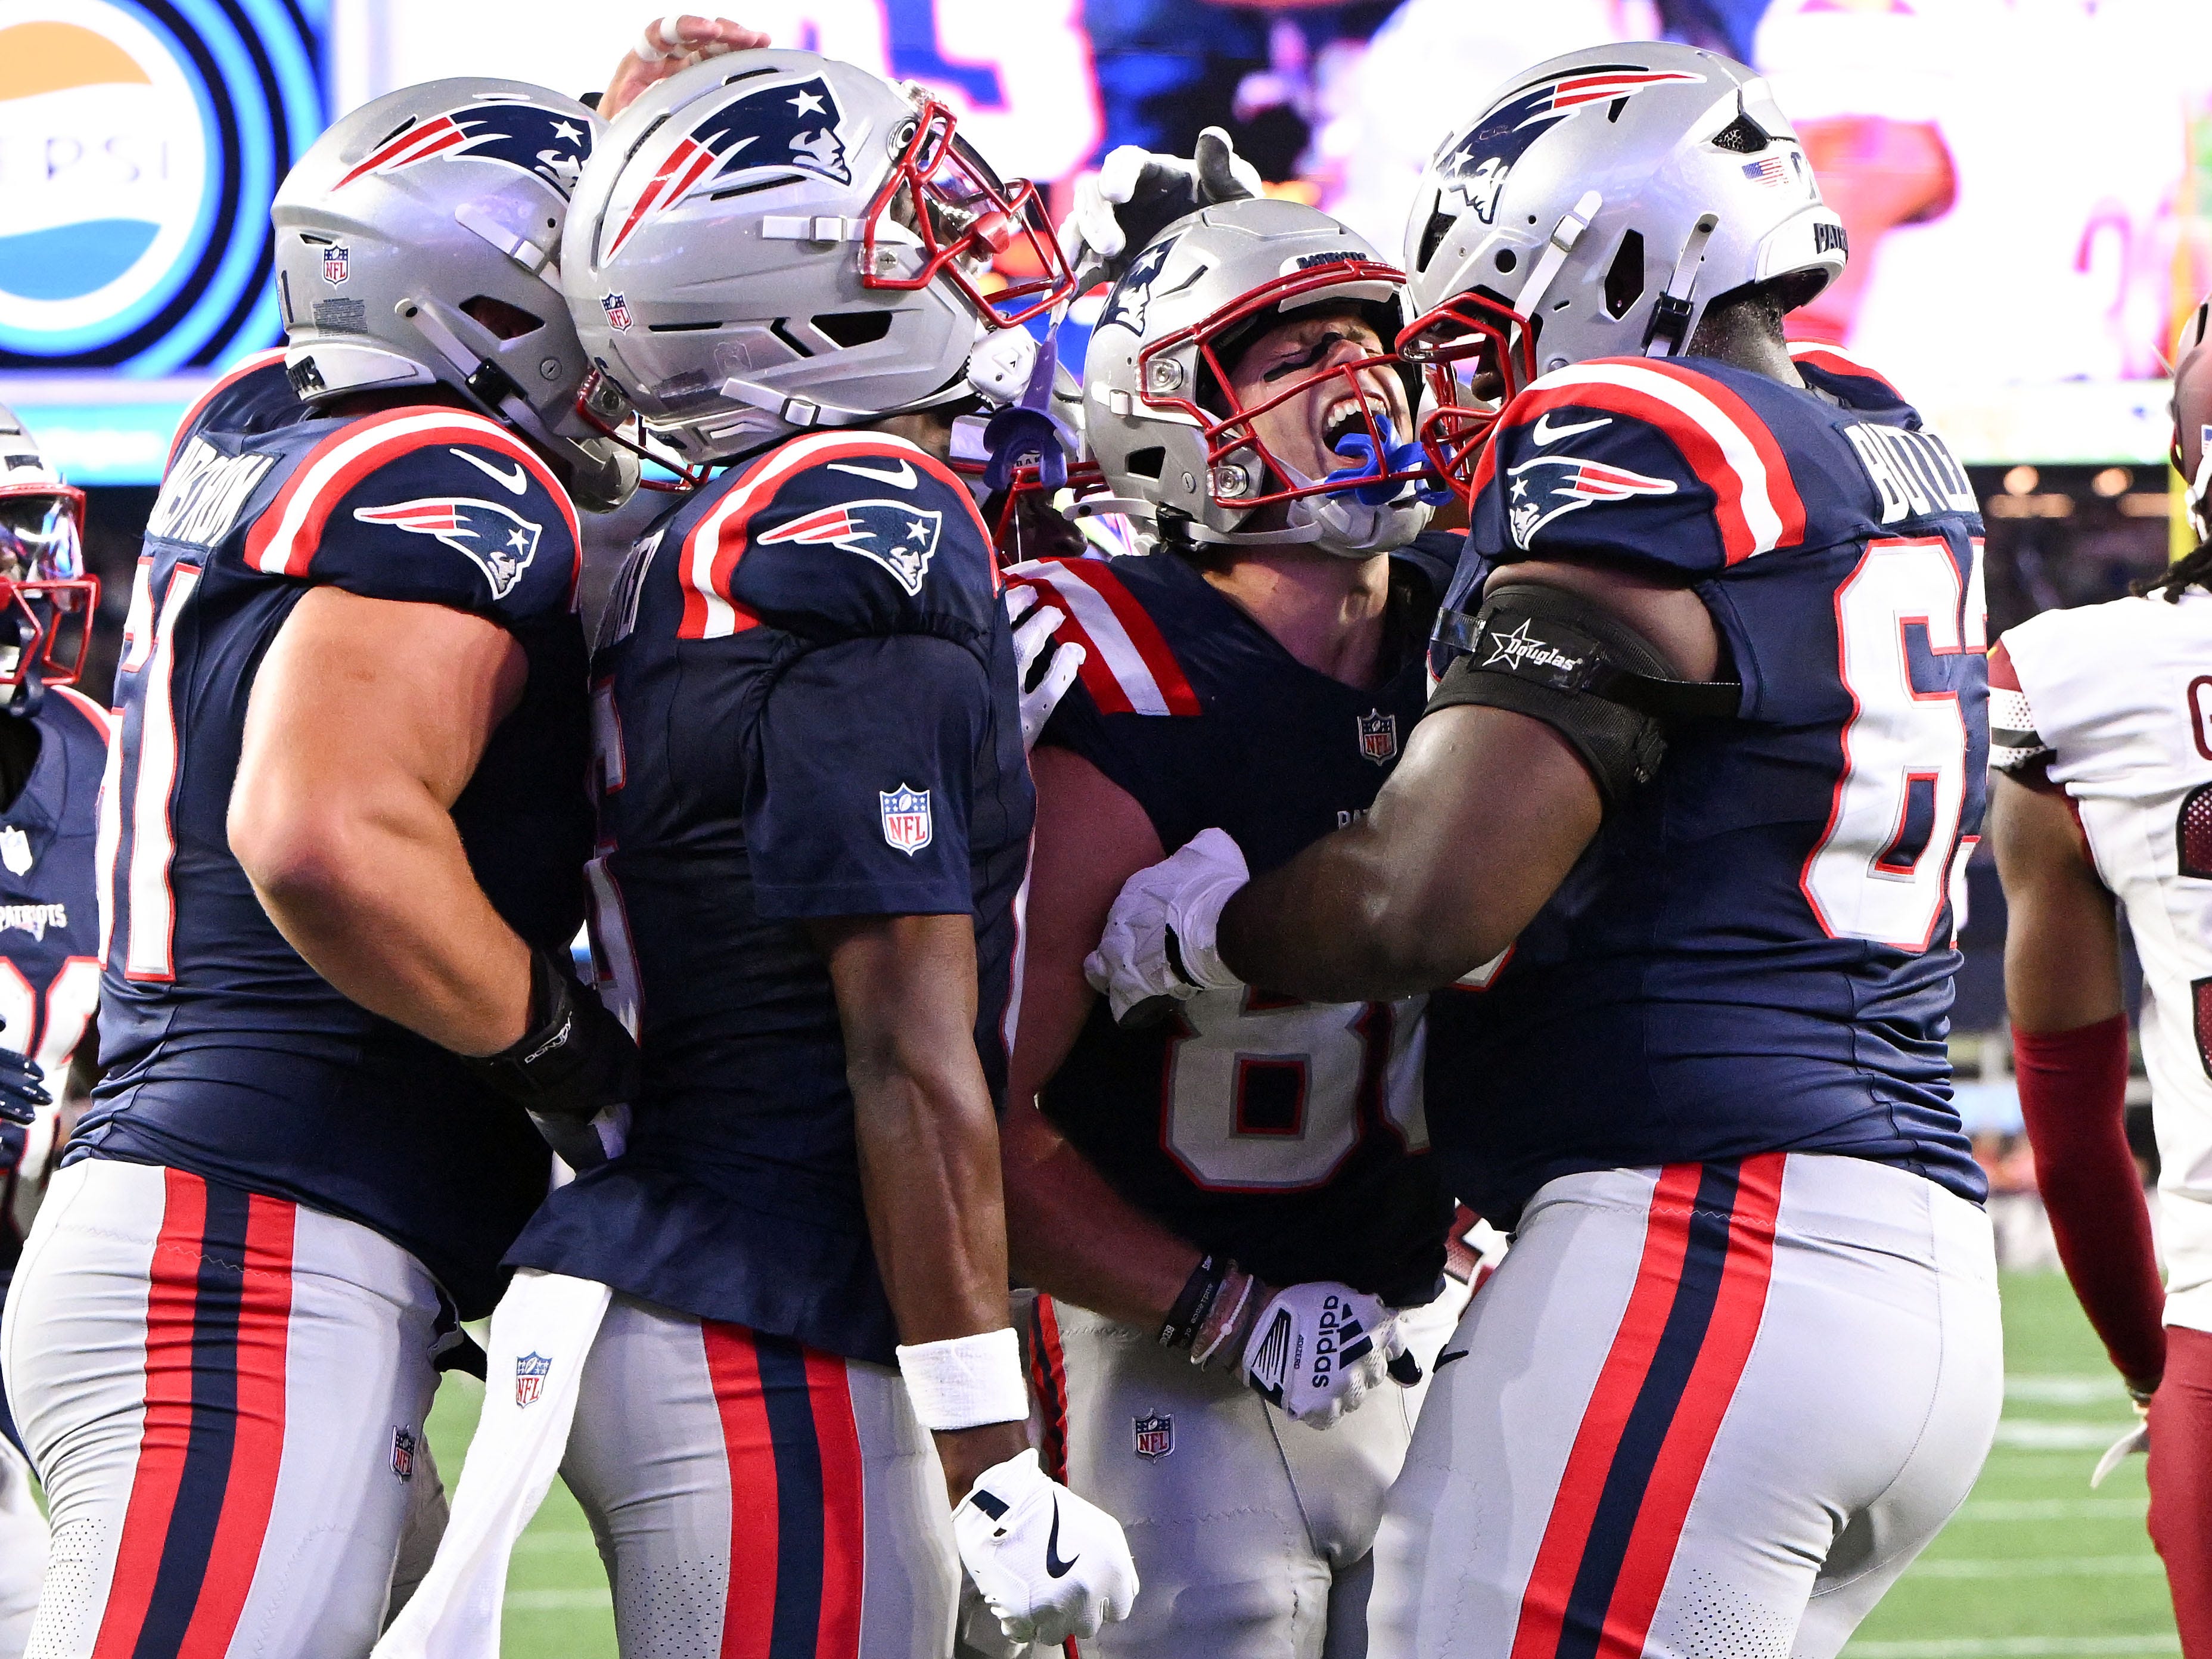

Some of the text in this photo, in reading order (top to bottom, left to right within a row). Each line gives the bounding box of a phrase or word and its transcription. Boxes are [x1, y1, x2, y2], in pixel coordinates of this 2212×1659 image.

[326, 262, 346, 281] NFL
[608, 309, 629, 328] NFL
[1843, 421, 1980, 525] BUTLE
[1504, 638, 1574, 672] Douglas
[1798, 535, 1988, 953] 6
[888, 815, 925, 845] NFL
[1293, 1334, 1304, 1370] ADIZERO
[1312, 1295, 1340, 1388] adidas
[517, 1377, 539, 1404] NFL
[1138, 1432, 1168, 1453] NFL
[394, 1447, 412, 1473] NFL
